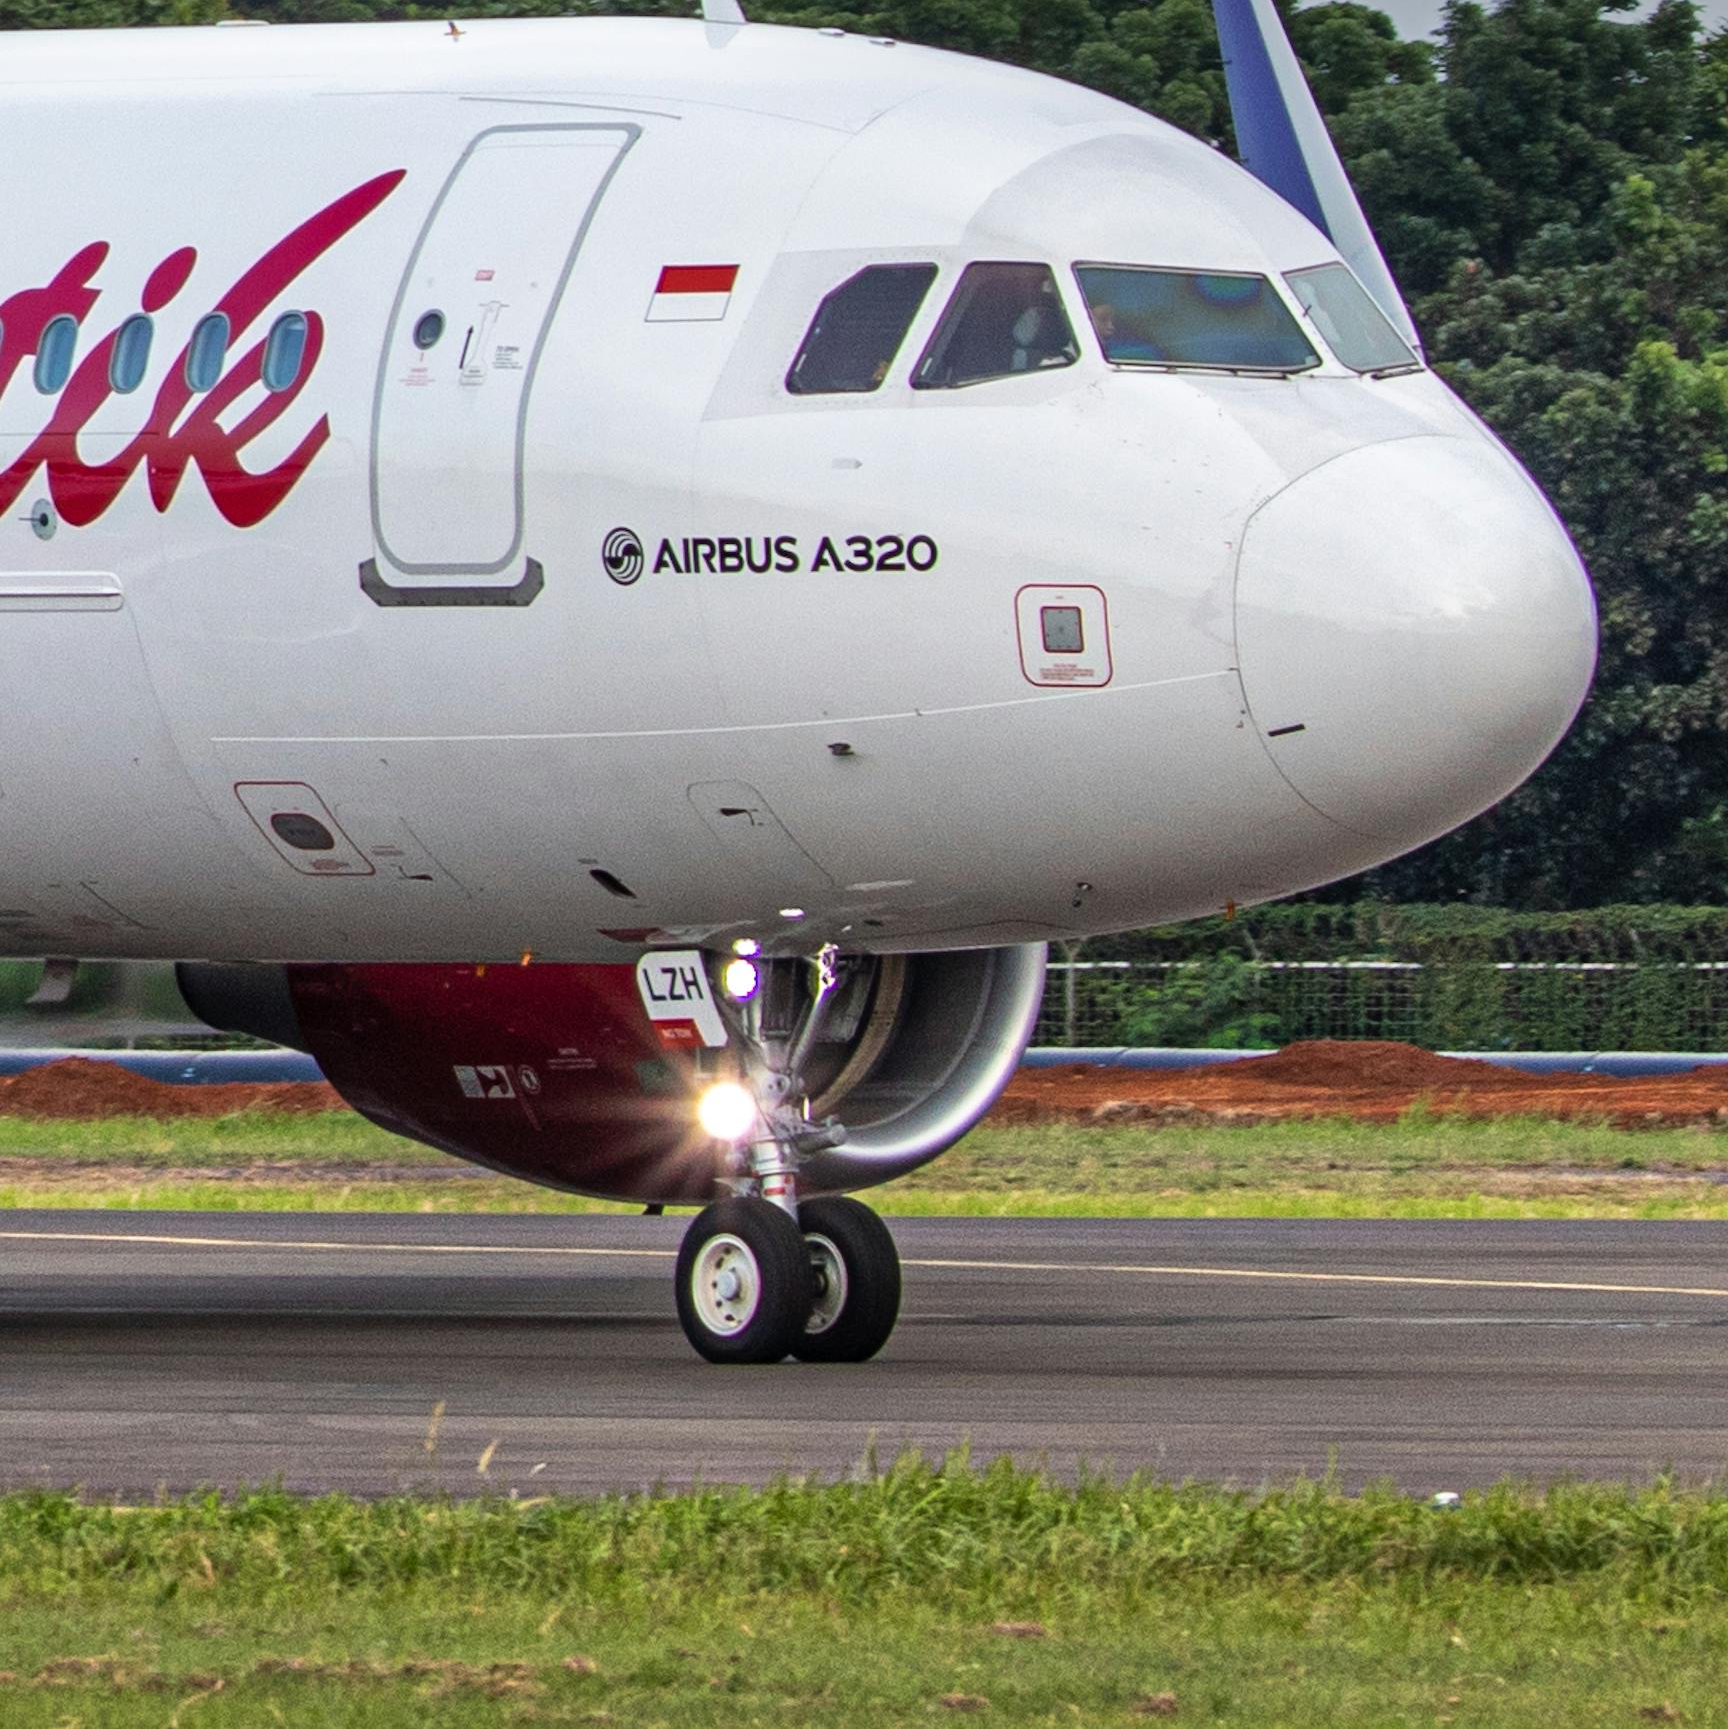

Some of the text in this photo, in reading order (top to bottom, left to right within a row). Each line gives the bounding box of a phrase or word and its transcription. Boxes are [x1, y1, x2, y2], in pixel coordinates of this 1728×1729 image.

[652, 534, 939, 575] AIRBUS A320
[641, 965, 705, 1002] LZH
